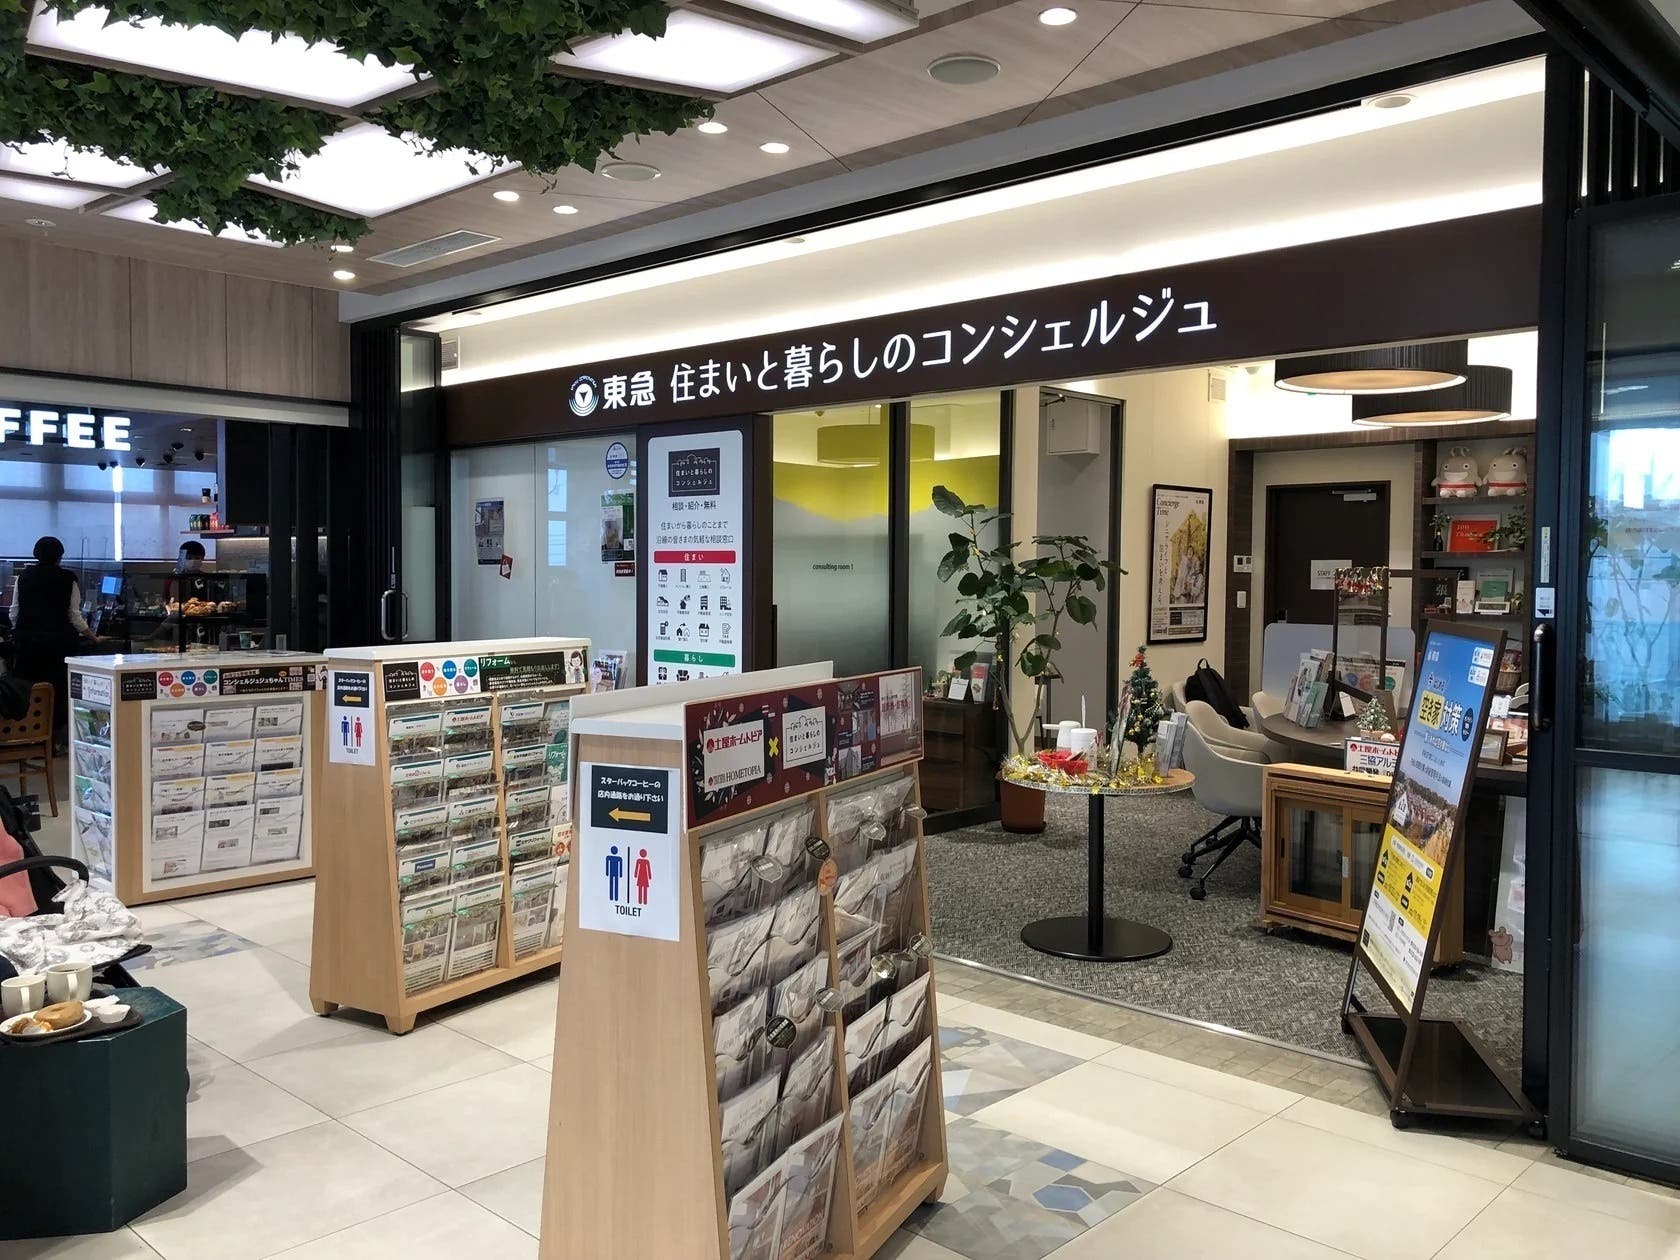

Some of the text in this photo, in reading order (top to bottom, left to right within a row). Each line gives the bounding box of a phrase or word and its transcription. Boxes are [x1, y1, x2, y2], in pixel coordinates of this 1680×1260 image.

[602, 286, 1218, 409] 東急 住まいと暮らしのコンシェルジュ
[675, 468, 713, 477] 住まいと暮らしの
[672, 501, 717, 511] 相談・紹介・無料
[660, 521, 729, 531] 住まいから暮らしのことまで
[684, 552, 704, 561] 住まい
[481, 657, 511, 667] リフォーム
[684, 653, 704, 663] 暮らし
[714, 729, 763, 751] 土屋ホームトピア
[726, 764, 761, 782] HOMETOPIA
[615, 905, 642, 917] TOILET
